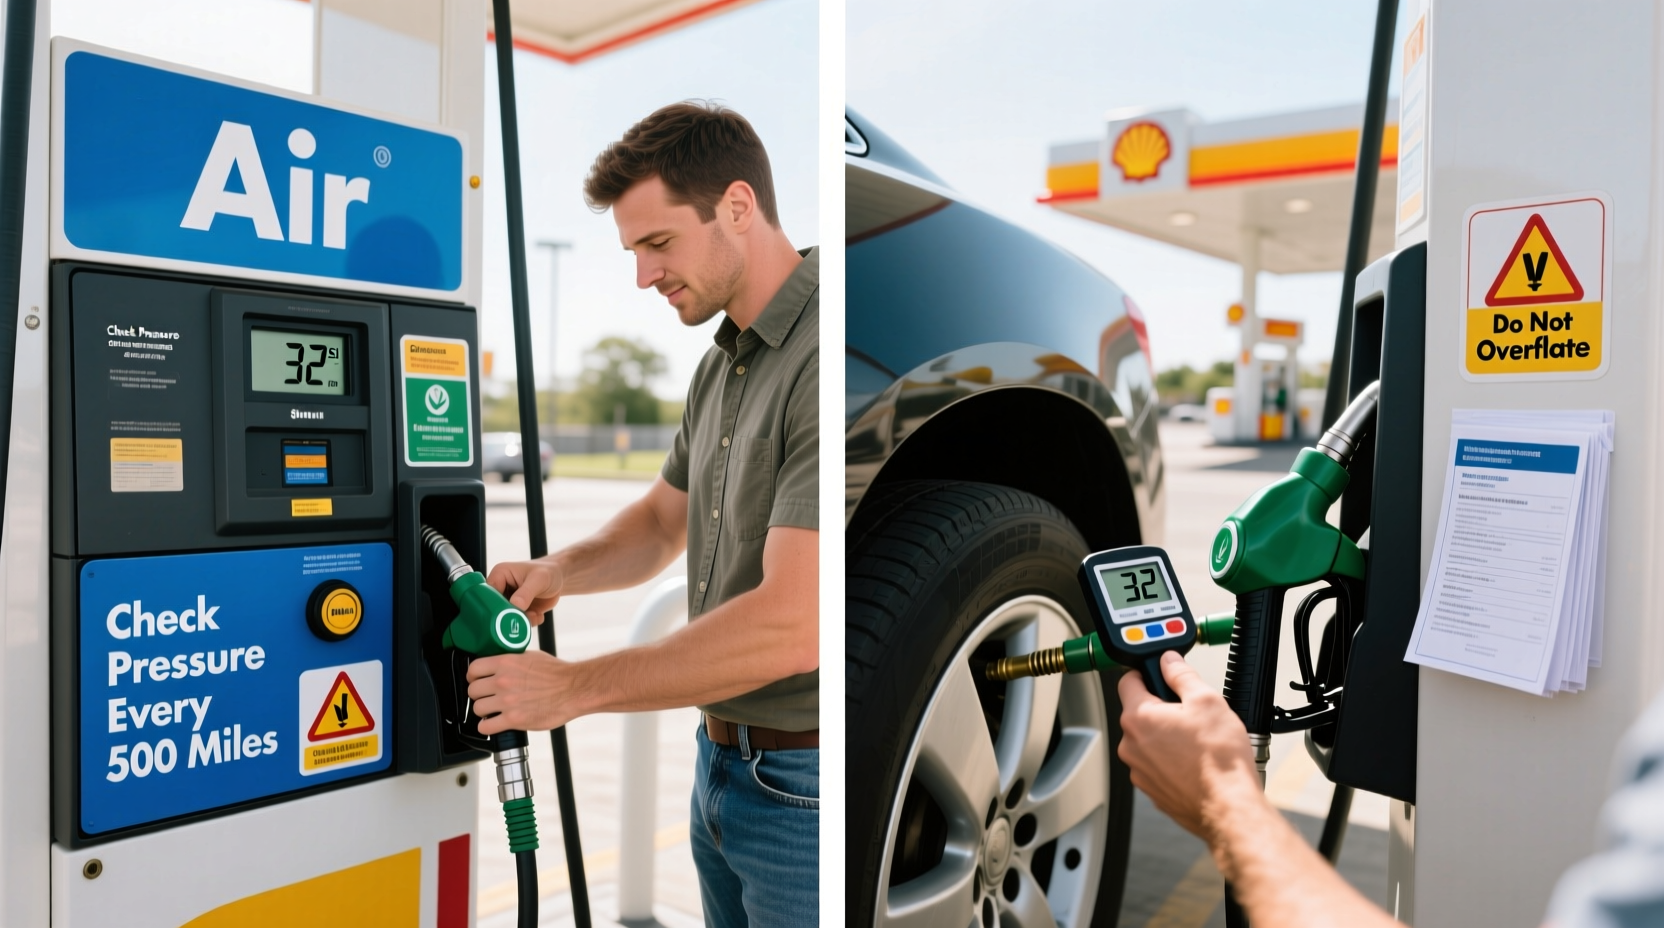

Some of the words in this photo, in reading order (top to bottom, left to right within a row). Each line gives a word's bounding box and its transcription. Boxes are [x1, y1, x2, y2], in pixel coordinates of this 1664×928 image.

[180, 120, 371, 250] Air
[1493, 314, 1523, 333] Do
[1530, 311, 1573, 332] Not
[284, 342, 328, 386] 32
[1476, 335, 1590, 361] Overflate
[1120, 568, 1158, 602] 32
[106, 594, 221, 640] Check
[108, 645, 266, 686] Pressure
[108, 696, 212, 734] Every
[106, 738, 178, 783] 500
[187, 723, 279, 769] Miles
